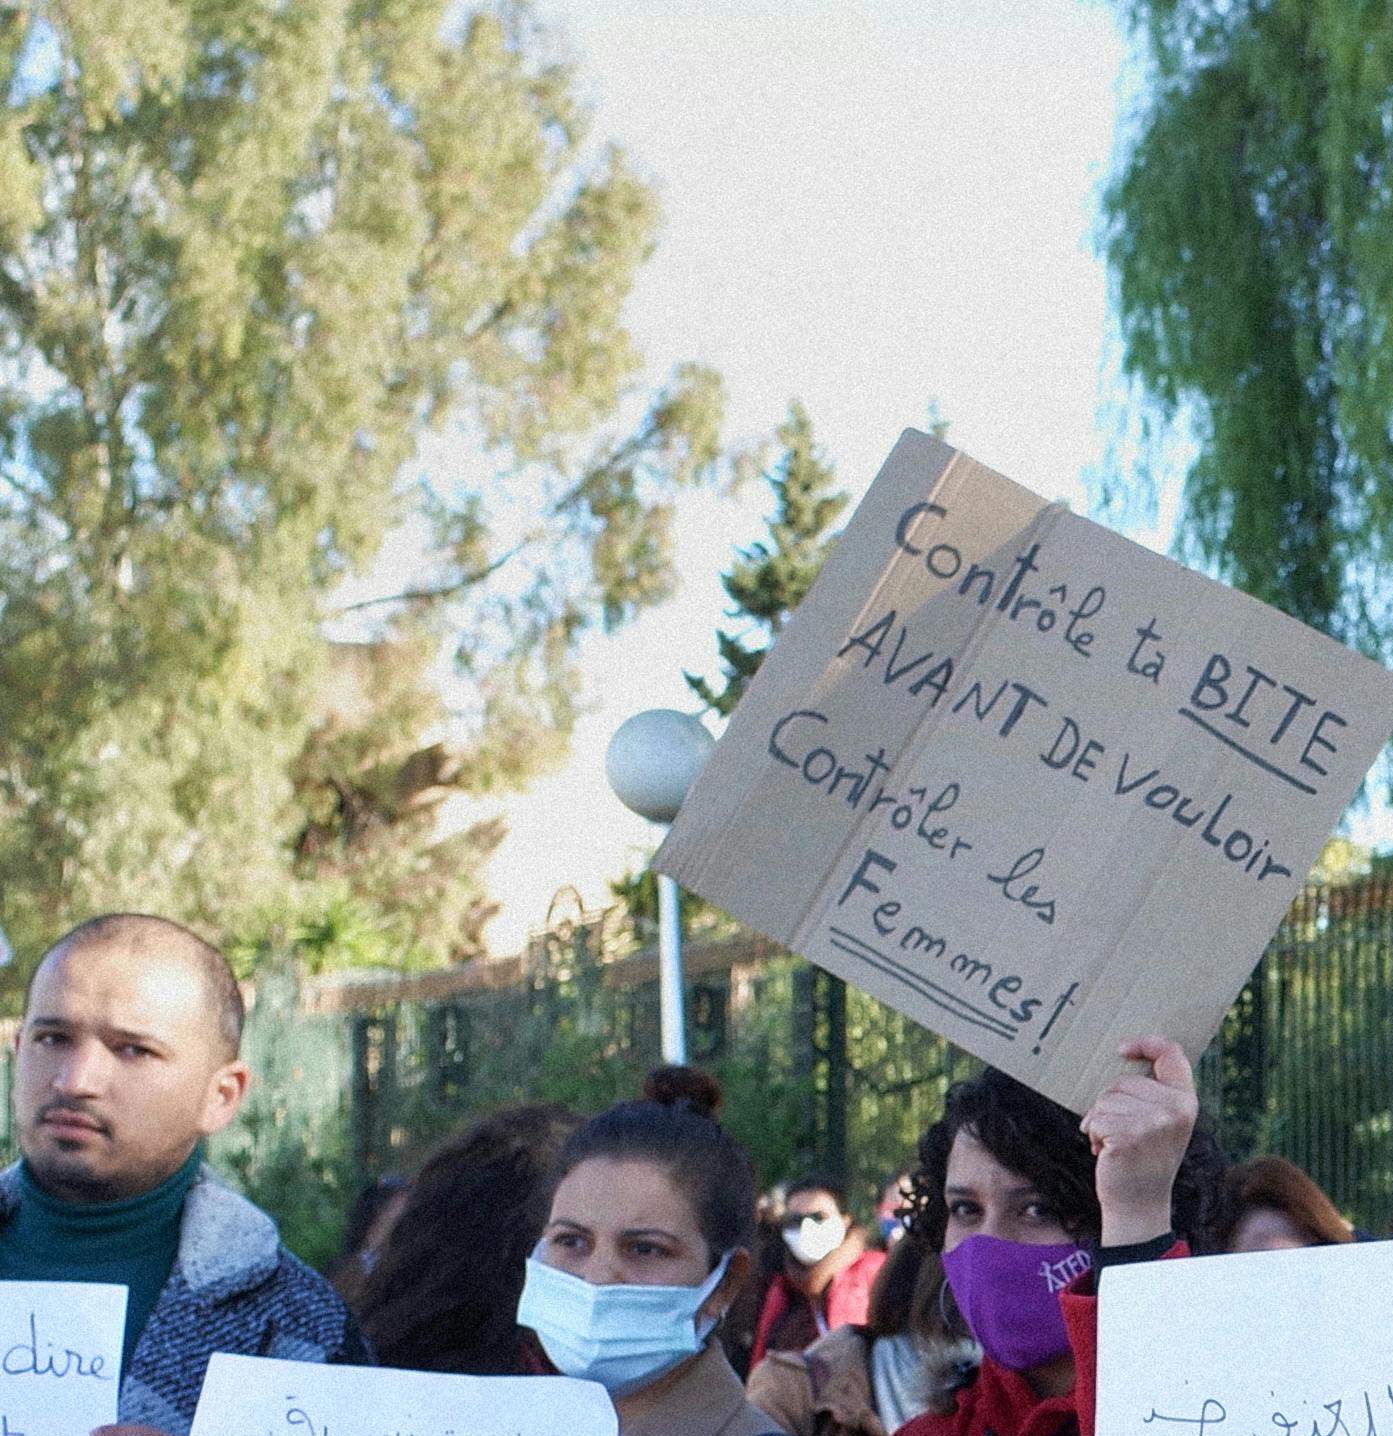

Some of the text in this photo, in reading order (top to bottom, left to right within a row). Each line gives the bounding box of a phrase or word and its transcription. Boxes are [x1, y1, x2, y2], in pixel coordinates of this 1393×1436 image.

[838, 611, 1048, 738] AVANT
[1040, 715, 1106, 783] DE
[895, 502, 1348, 778] Contrôle ta BITE
[769, 711, 1055, 924] Contrôler les
